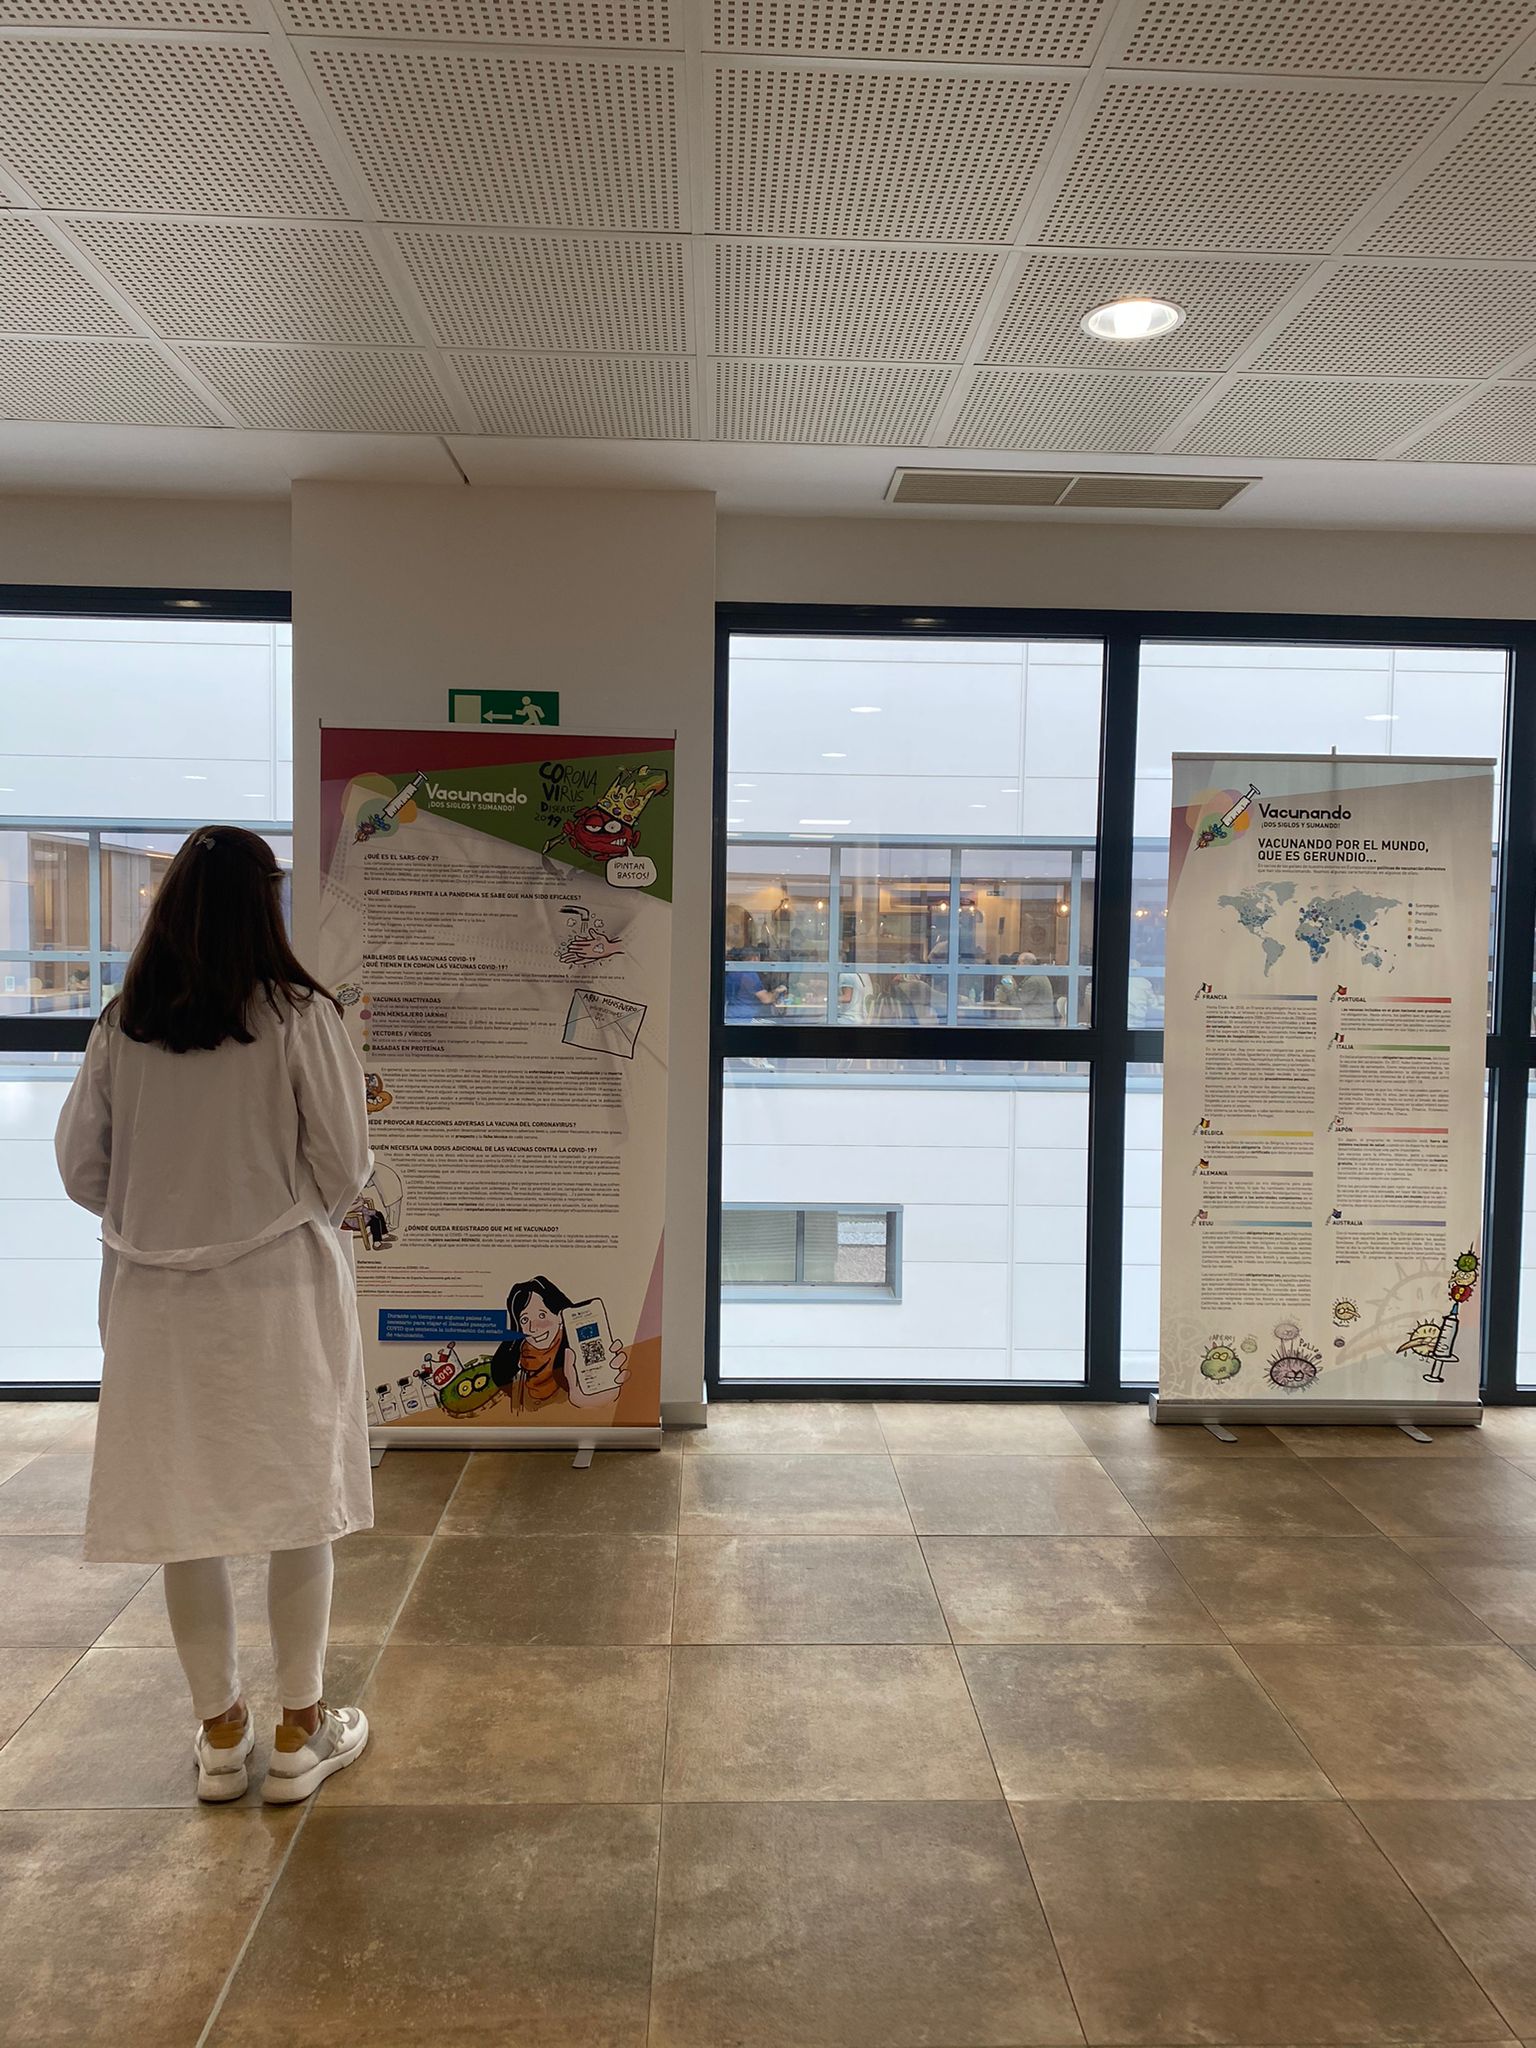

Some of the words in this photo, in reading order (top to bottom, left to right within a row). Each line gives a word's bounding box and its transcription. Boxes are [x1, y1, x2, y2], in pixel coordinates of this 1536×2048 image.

[539, 761, 597, 795] CORONA
[425, 782, 528, 804] Vacunando
[542, 783, 584, 802] VIRUS
[427, 801, 444, 809] ¡DOS
[446, 801, 470, 809] SIGLOS
[478, 803, 515, 811] SUMANDO!
[1258, 803, 1351, 819] Vacunando
[535, 812, 562, 828] 2019
[1257, 838, 1331, 850] VACUNANDO
[1335, 840, 1359, 850] POR
[1363, 840, 1377, 850] EL
[1381, 840, 1429, 852] MUNDO,
[364, 853, 379, 862] ¿QUÉ
[1258, 851, 1281, 861] QUE
[1285, 851, 1299, 861] ES
[1303, 851, 1377, 862] GERUNDIO...
[617, 871, 650, 879] BASTOS!
[363, 888, 378, 898] ¿QUÉ
[362, 961, 377, 970] ¿QUÉ
[410, 1044, 445, 1052] PROTEÍNAS
[370, 1143, 388, 1151] QUIÉN
[404, 1225, 428, 1233] ¿DÓNDE
[435, 1365, 453, 1383] 2019
